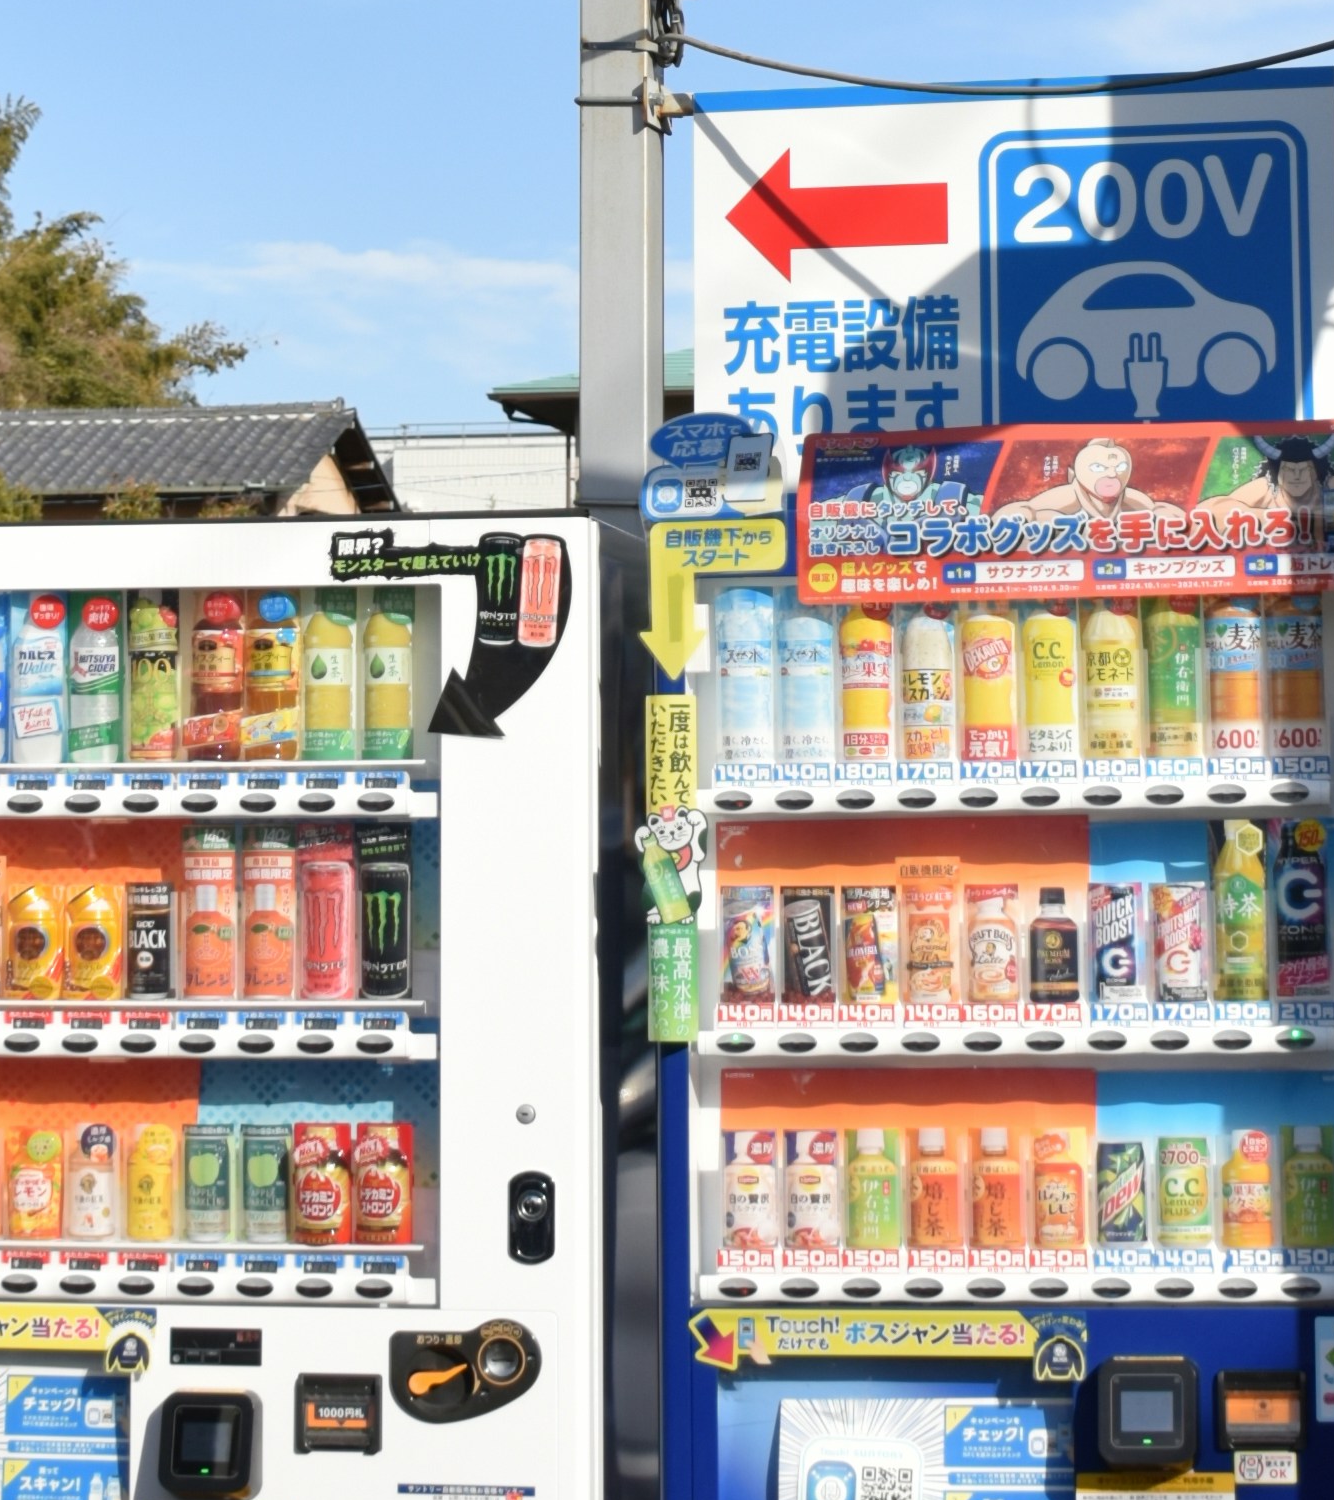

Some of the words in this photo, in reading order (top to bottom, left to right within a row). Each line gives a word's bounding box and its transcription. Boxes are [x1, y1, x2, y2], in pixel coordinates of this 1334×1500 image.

[1013, 153, 1272, 244] 200V
[724, 295, 960, 374] 充電設備
[665, 421, 743, 438] スマホで
[670, 438, 725, 458] 応募
[665, 527, 772, 549] 自販機下から
[809, 524, 881, 541] オリジナル
[337, 537, 385, 556] 限界?
[681, 548, 750, 567] スタート
[986, 563, 1071, 579] サウナグッズ
[1133, 560, 1225, 575] キャンプグッズ
[650, 704, 667, 807] いただきたい
[669, 704, 693, 806] 一度は飲んで
[717, 764, 771, 781] 140円
[775, 764, 831, 781] 140円
[837, 764, 890, 780] 180円
[899, 764, 953, 780] 170円
[962, 762, 1016, 780] 170円
[1023, 760, 1077, 777] 170円
[1085, 759, 1139, 776] 180円
[1148, 758, 1203, 775] 160円
[1209, 758, 1265, 774] 150円
[1272, 756, 1329, 773] 150円
[672, 937, 693, 1037] 最高水準の
[718, 1005, 774, 1021] 140円
[779, 1005, 834, 1021] 140円
[840, 1005, 895, 1021] 140円
[906, 1005, 961, 1021] 140円
[963, 1005, 1017, 1021] 160円
[1028, 1003, 1083, 1019] 170円
[1101, 1003, 1149, 1019] 170円
[1153, 1003, 1211, 1019] 170円
[1217, 1003, 1273, 1019] 190円
[718, 1250, 774, 1266] 150円
[784, 1250, 839, 1266] 150円
[843, 1250, 899, 1266] 150円
[909, 1250, 964, 1266] 150円
[971, 1250, 1027, 1266] 150円
[1030, 1250, 1088, 1266] 150円
[1096, 1250, 1151, 1266] 140円
[1156, 1250, 1214, 1266] 140円
[1229, 1250, 1284, 1266] 150円
[765, 1316, 840, 1335] Touch!
[844, 1322, 1027, 1347] ボスジャン当たる!
[777, 1337, 830, 1351] だけでも
[318, 1406, 365, 1419] 1000円札
[1269, 1468, 1288, 1480] OK
